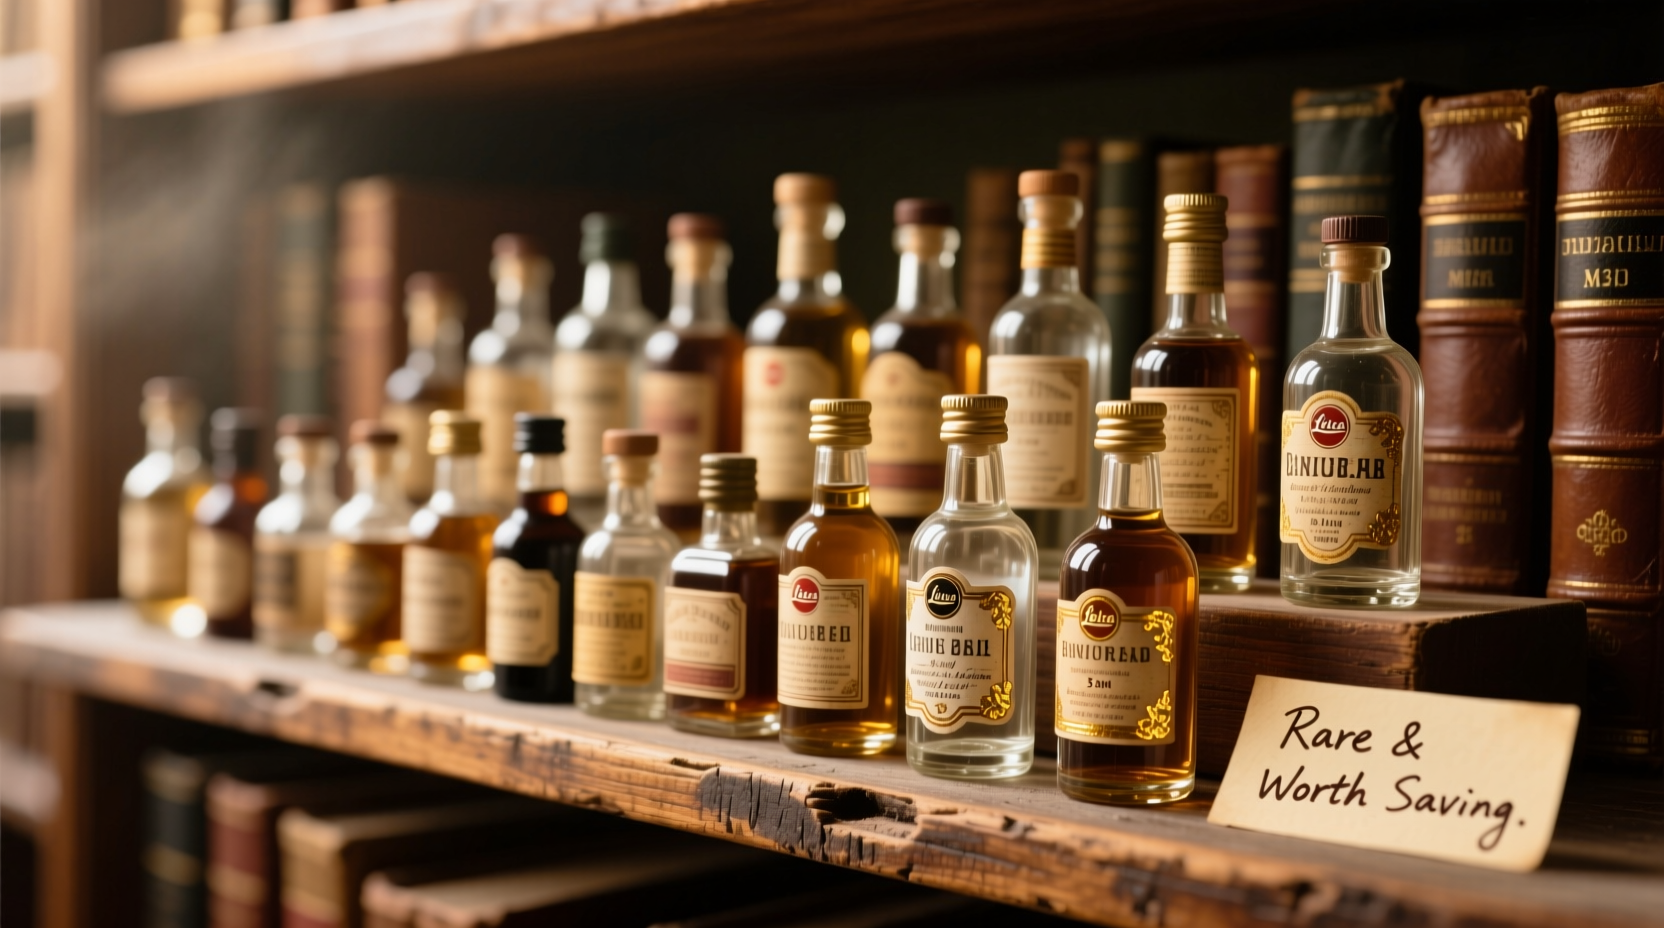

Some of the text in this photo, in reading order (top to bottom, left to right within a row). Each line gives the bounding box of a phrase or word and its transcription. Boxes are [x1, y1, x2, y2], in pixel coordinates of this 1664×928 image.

[1280, 705, 1424, 760] Rare &
[1258, 765, 1527, 851] Worth Saving.
